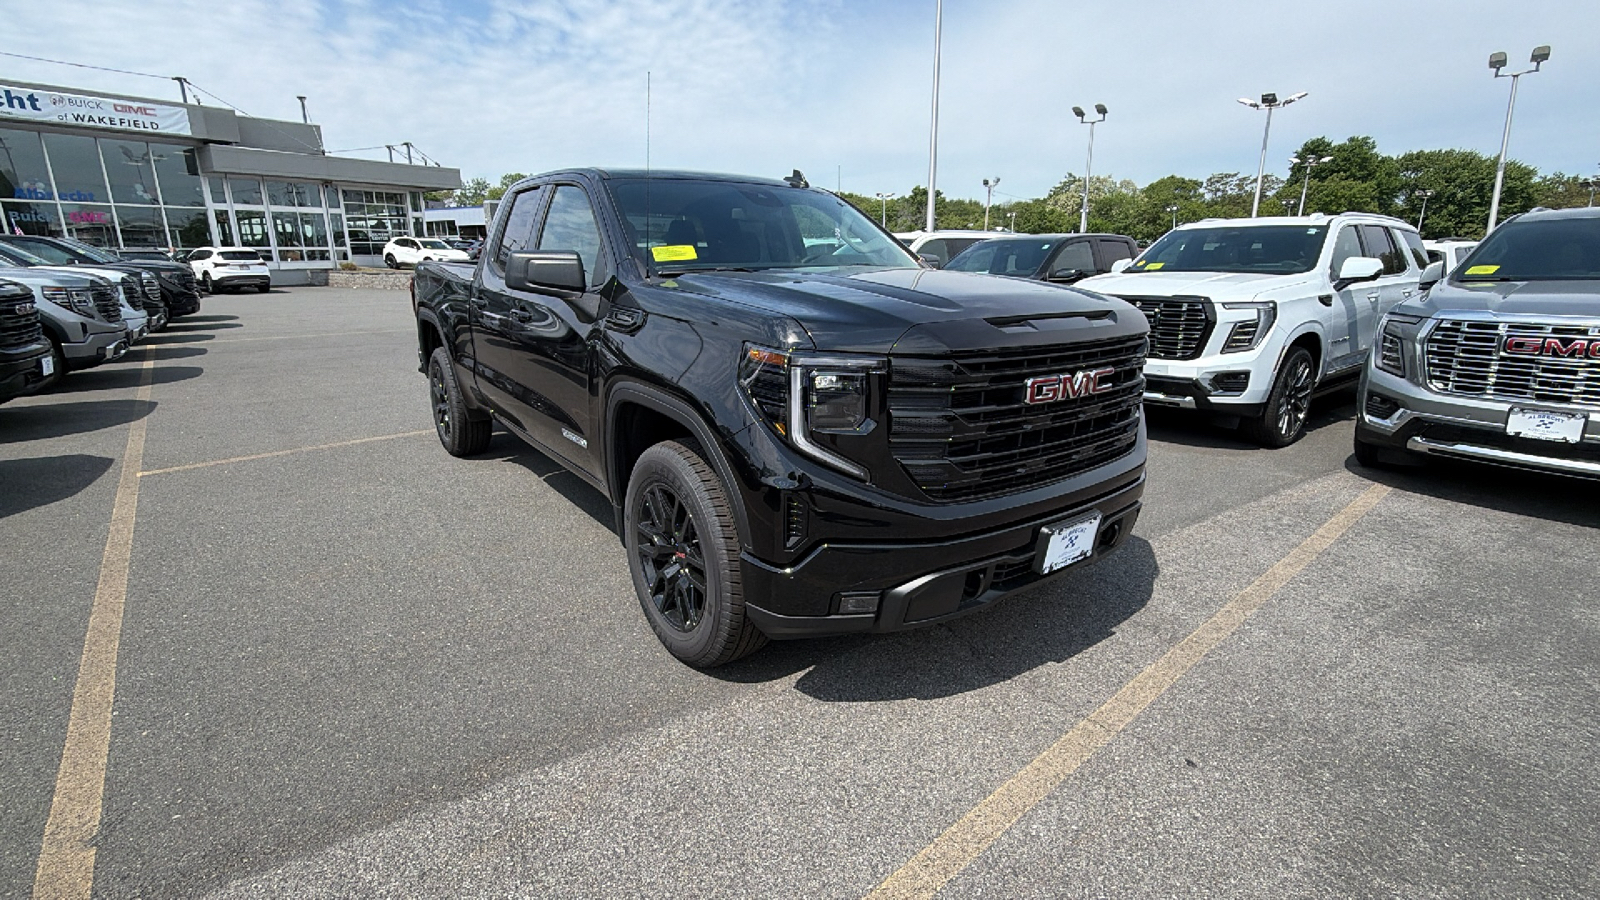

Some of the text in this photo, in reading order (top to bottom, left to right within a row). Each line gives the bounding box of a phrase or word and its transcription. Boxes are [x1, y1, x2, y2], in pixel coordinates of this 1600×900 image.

[67, 97, 157, 117] BUICK GMC
[57, 112, 160, 130] of WAKEFIELD
[69, 211, 107, 224] GMC
[1025, 367, 1115, 405] GMC
[1528, 414, 1565, 423] ALBRECHT
